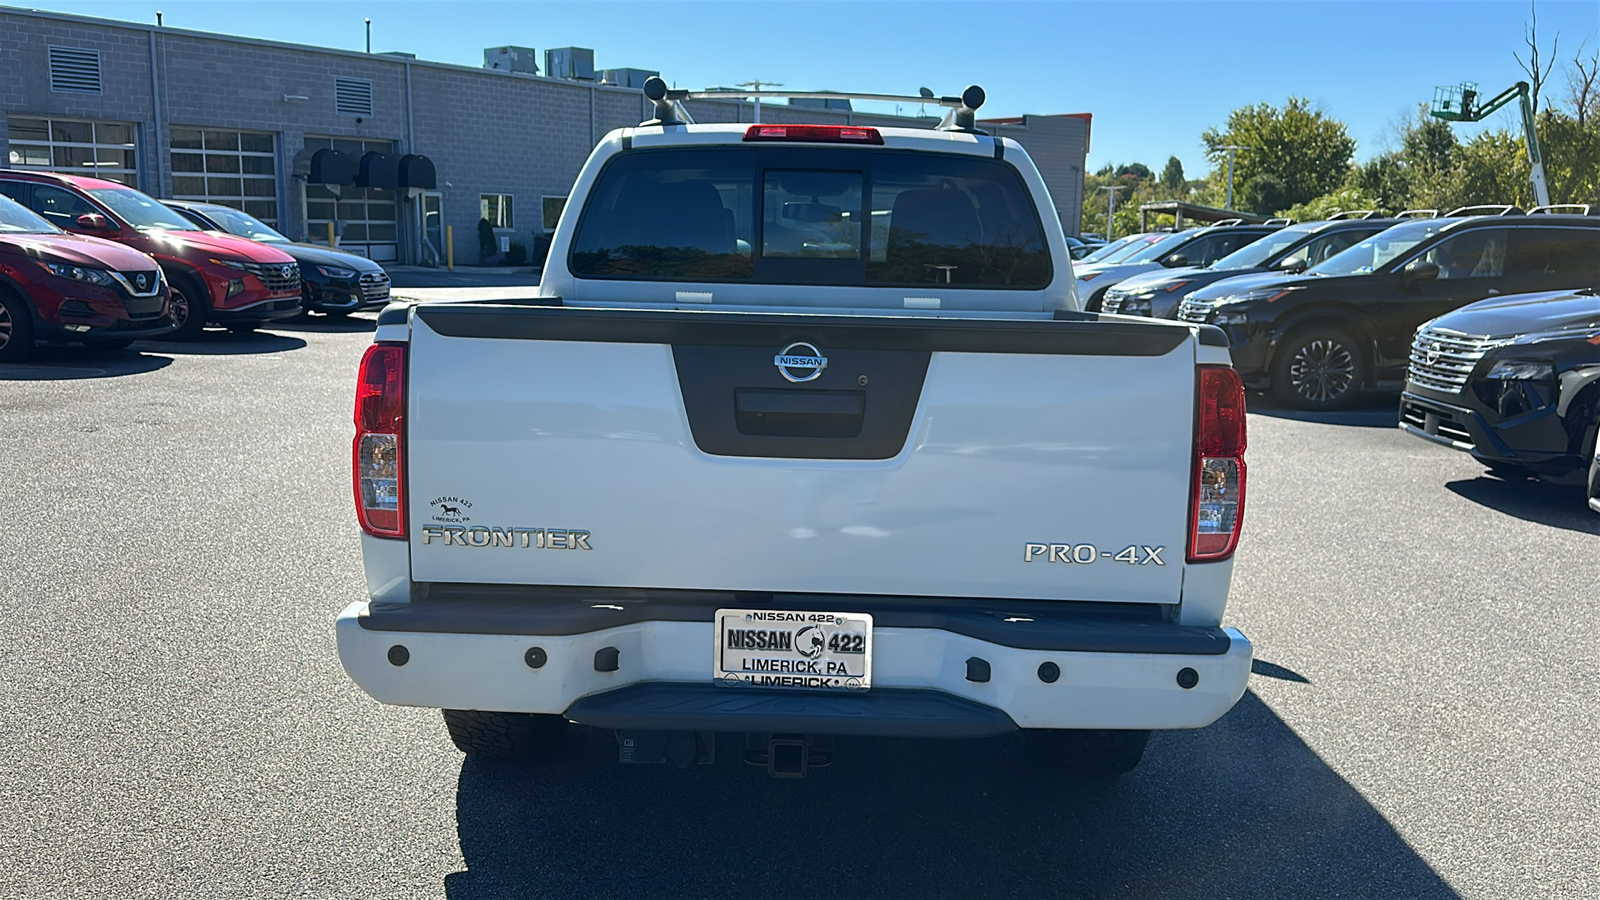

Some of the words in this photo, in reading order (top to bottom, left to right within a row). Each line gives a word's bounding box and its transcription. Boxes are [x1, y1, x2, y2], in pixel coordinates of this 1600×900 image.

[780, 357, 822, 366] NISSAN
[430, 496, 458, 507] NISSAN
[460, 498, 473, 508] 422
[422, 524, 593, 550] FRONTIER
[1024, 542, 1166, 566] PRO-4X
[753, 612, 806, 622] NISSAN
[808, 614, 835, 623] 422
[727, 629, 791, 650] NISSAN
[828, 634, 864, 652] 422
[742, 658, 822, 675] LIMERICK,
[827, 662, 848, 674] PA
[751, 675, 833, 689] LIMERICK
